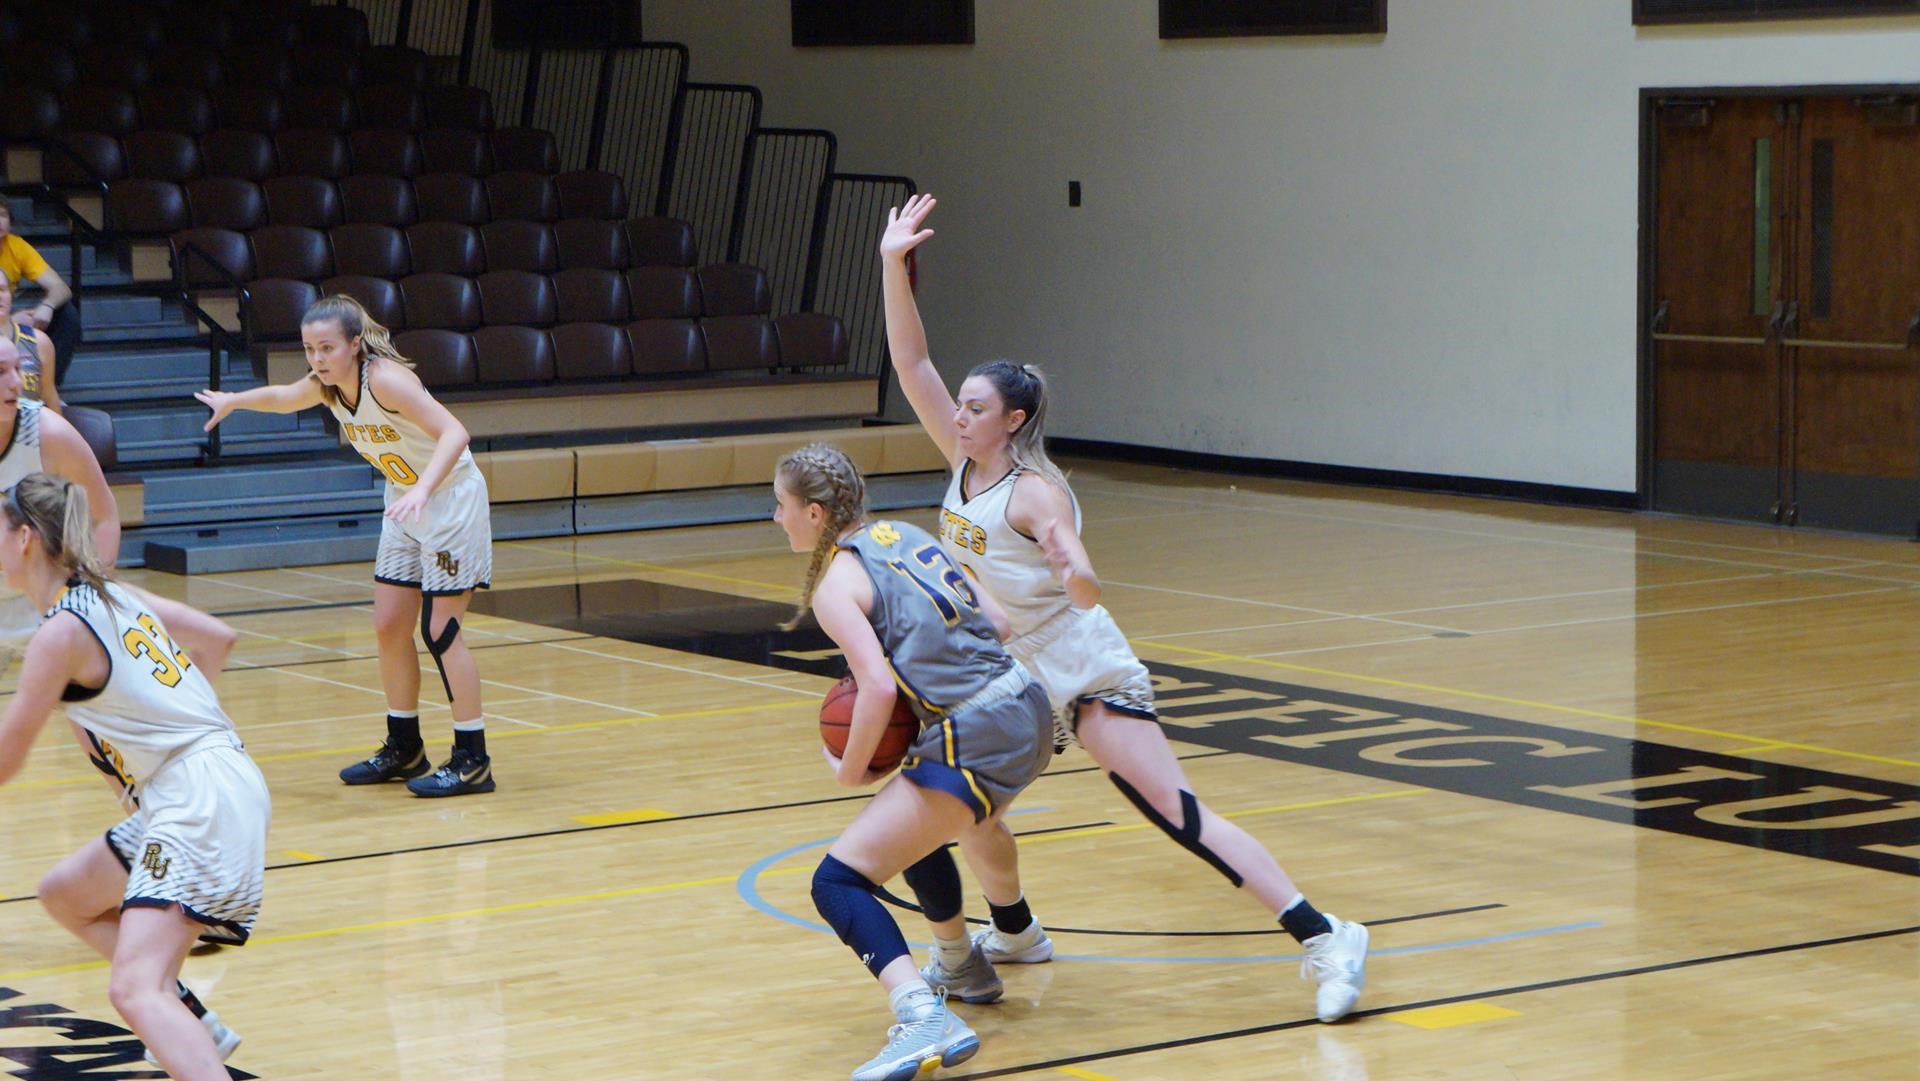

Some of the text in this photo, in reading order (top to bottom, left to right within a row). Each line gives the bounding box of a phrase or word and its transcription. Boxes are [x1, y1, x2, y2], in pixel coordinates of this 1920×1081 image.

[941, 507, 987, 556] TES
[122, 611, 191, 688] 32
[1524, 765, 1920, 860] LU
